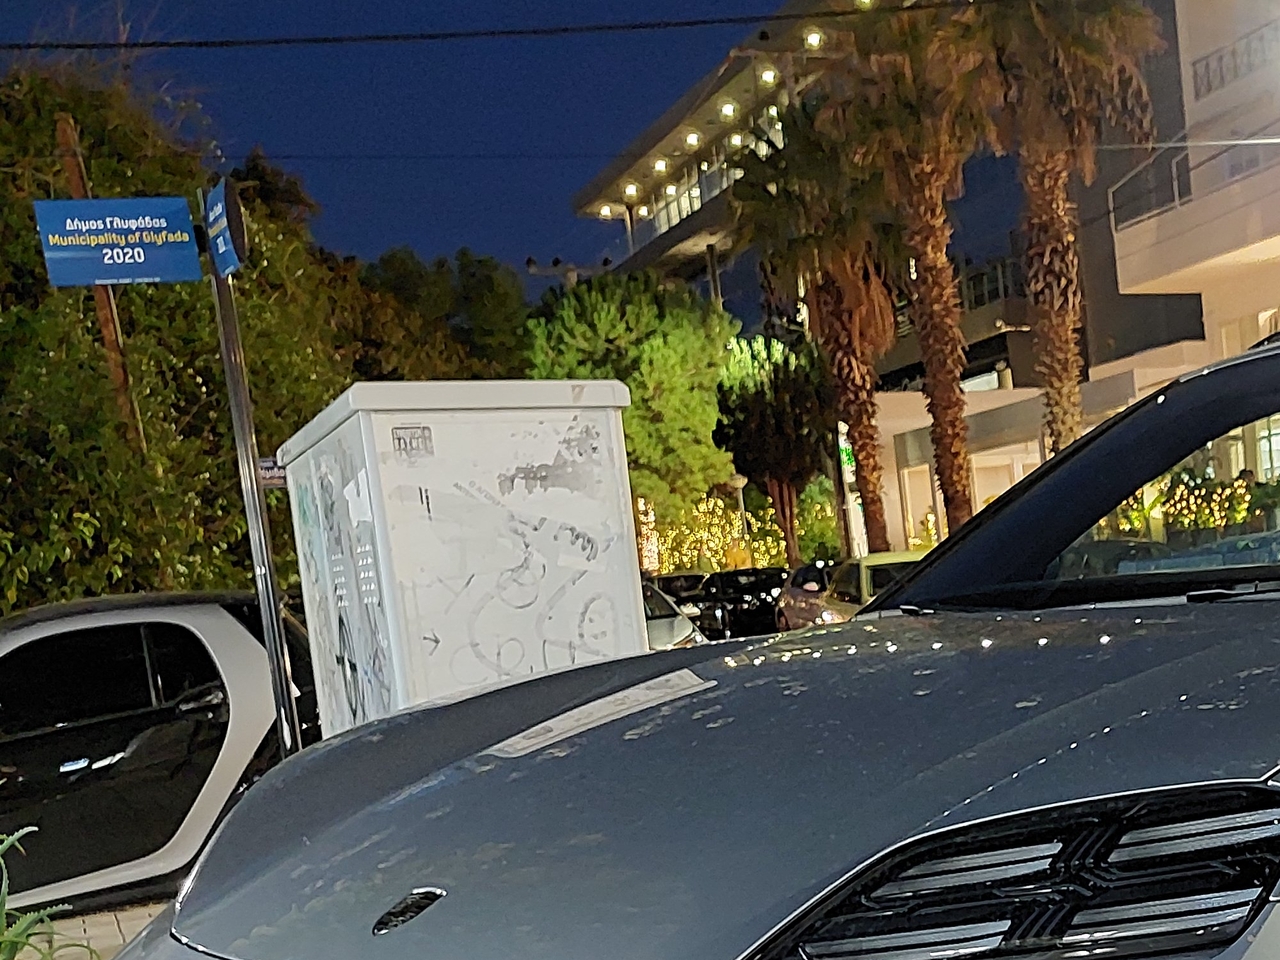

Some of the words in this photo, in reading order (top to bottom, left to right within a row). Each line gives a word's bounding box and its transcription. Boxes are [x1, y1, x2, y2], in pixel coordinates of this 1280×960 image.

[65, 217, 104, 232] Δήμος
[105, 216, 168, 231] Γλυφάδας
[48, 232, 126, 247] Municipality
[127, 232, 141, 244] of
[142, 230, 190, 246] Glyfada
[102, 247, 145, 264] 2020
